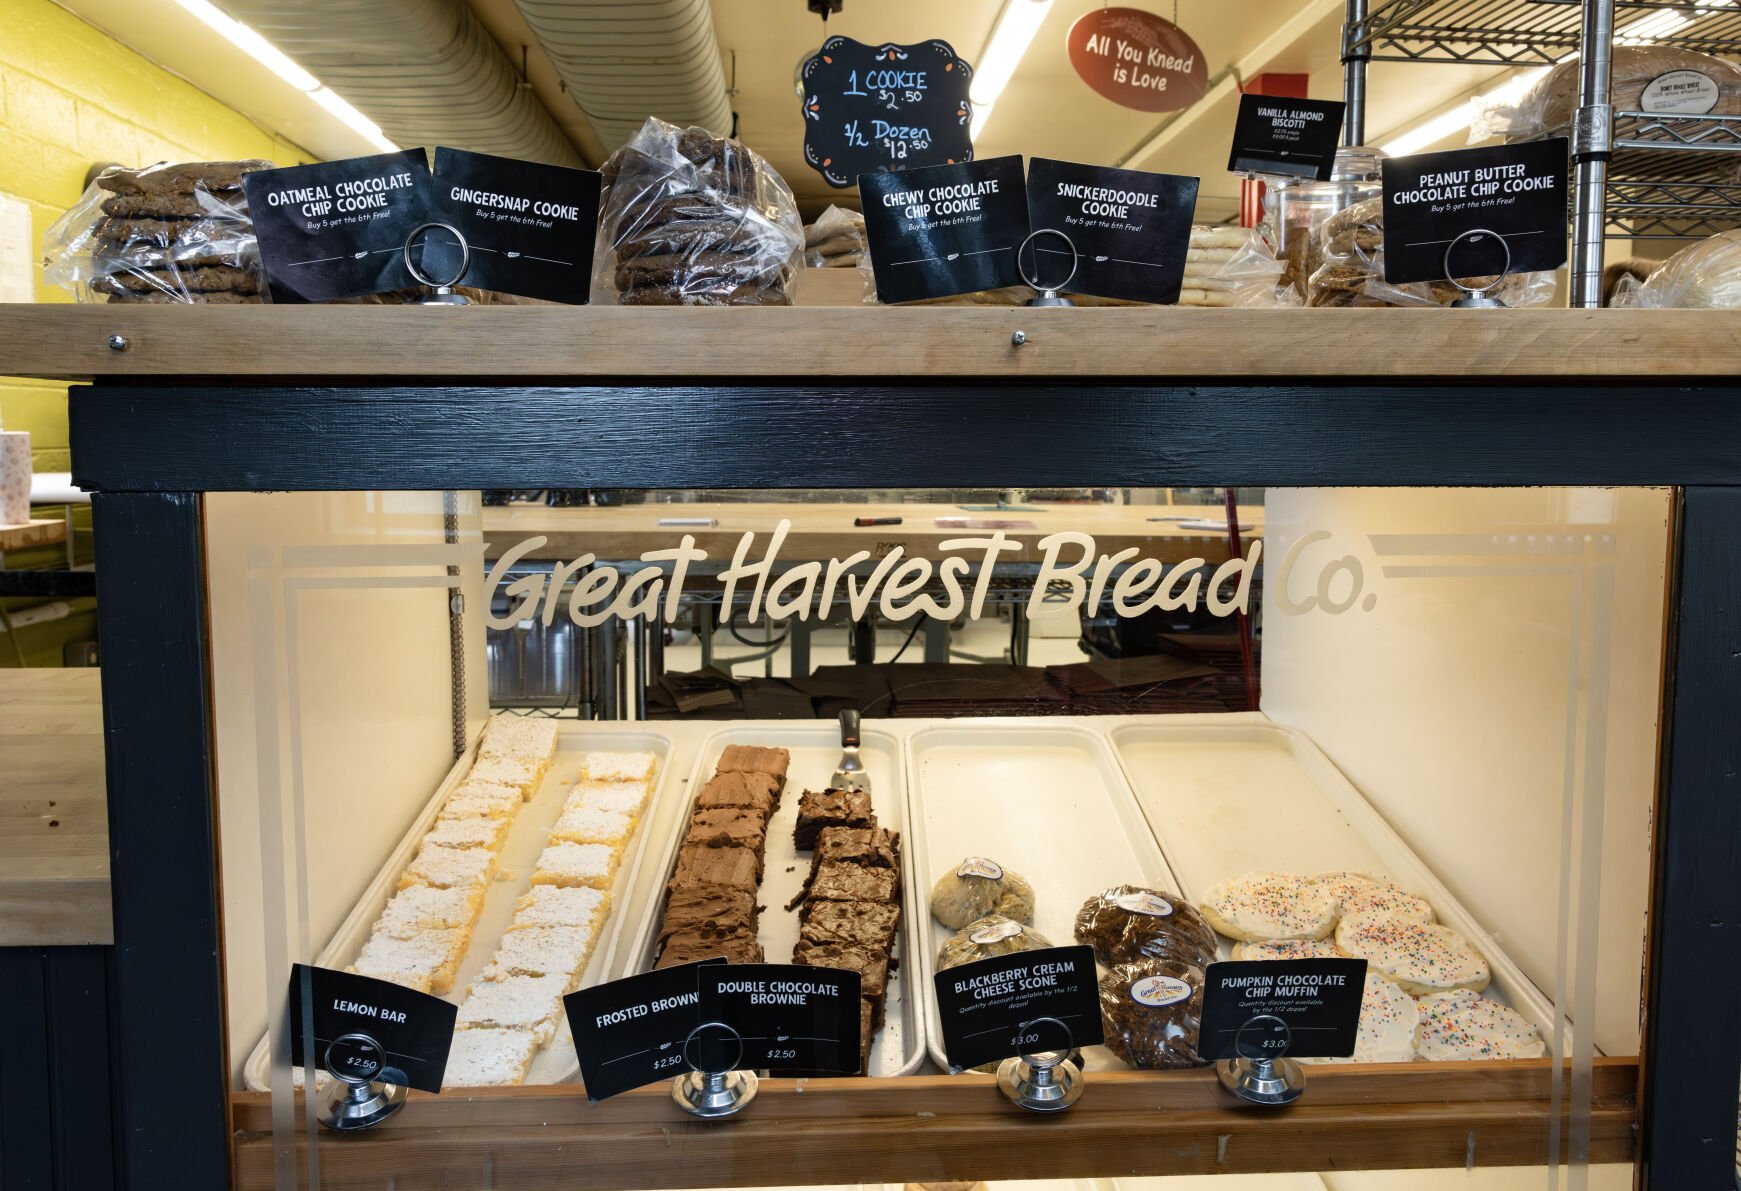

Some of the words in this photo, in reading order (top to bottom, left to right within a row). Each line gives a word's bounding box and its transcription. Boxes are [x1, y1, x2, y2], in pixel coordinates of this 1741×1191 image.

[1086, 33, 1110, 57] All
[1116, 40, 1142, 62] You
[1148, 47, 1194, 74] Knead
[843, 70, 867, 96] 1
[866, 71, 927, 89] COOKIE
[1113, 63, 1127, 83] is
[1131, 67, 1168, 91] Love
[879, 90, 922, 110] $2.50
[1257, 107, 1287, 119] VANILLA
[1290, 111, 1324, 121] ALMOND
[1271, 118, 1305, 129] BISCOTTI
[844, 120, 869, 147] 1/2
[872, 120, 931, 142] Dozen
[884, 139, 928, 159] $12.50
[1420, 170, 1470, 187] PEANUT
[1474, 164, 1526, 181] BUTTER
[267, 183, 332, 206] OATMEAL
[335, 173, 413, 198] CHOCOLATE
[883, 189, 926, 207] CHEWY
[928, 180, 999, 201] CHOCOLATE
[1057, 183, 1159, 208] SNICKERDOODLE
[1394, 186, 1466, 206] CHOCOLATE
[1471, 182, 1500, 196] CHIP
[1504, 175, 1555, 193] COOKIE
[302, 199, 331, 217] CHIP
[336, 192, 388, 212] COOKIE
[450, 187, 531, 213] GINGERSNAP
[533, 200, 579, 221] COOKIE
[905, 204, 931, 219] CHIP
[935, 197, 981, 215] COOKIE
[1082, 201, 1128, 219] COOKIE
[1431, 204, 1444, 213] Buy
[1453, 202, 1465, 212] get
[1467, 200, 1480, 209] the
[1482, 198, 1495, 207] 6th
[1496, 196, 1515, 206] Free!
[307, 220, 321, 230] Buy
[322, 219, 328, 227] 5
[329, 217, 342, 228] get
[344, 214, 356, 224] the
[358, 212, 371, 222] 6th
[373, 210, 390, 220] Free!
[476, 209, 489, 220] Buy
[496, 213, 508, 223] get
[509, 214, 522, 224] the
[522, 217, 535, 226] 6th
[536, 218, 553, 229] Free!
[908, 223, 921, 232] Buy
[927, 220, 939, 230] get
[940, 218, 951, 226] the
[965, 214, 982, 224] Free!
[1065, 216, 1078, 225] Buy
[1085, 218, 1097, 228] get
[1098, 220, 1109, 228] the
[1123, 223, 1143, 232] Free!
[485, 533, 708, 630] Great
[716, 517, 1024, 622] Harvest
[1025, 530, 1262, 621] Bread
[1274, 529, 1378, 617] Co.
[955, 967, 1029, 993] BLACKBERRY
[1033, 962, 1074, 974] CREAM
[974, 982, 1015, 999] CHEESE
[1020, 975, 1057, 990] SCONE
[1222, 976, 1273, 988] PUMPKIN
[1278, 976, 1346, 986] CHOCOLATE
[717, 981, 767, 995] DOUBLE
[769, 981, 840, 997] CHOCOLATE
[1246, 987, 1271, 997] CHIP
[1275, 987, 1318, 996] MUFFIN
[750, 993, 807, 1006] BROWNIE
[959, 1002, 987, 1014] Quantity
[988, 996, 1014, 1006] discount
[1015, 992, 1043, 1001] available
[1009, 1001, 1029, 1009] dozen!
[334, 999, 377, 1016] LEMON
[381, 1009, 407, 1023] BAR
[596, 1005, 648, 1028] FROSTED
[1010, 1034, 1039, 1046] $3.00
[347, 1057, 377, 1069] $2.50
[653, 1055, 682, 1069] $2.50
[766, 1048, 797, 1061] $2.50
